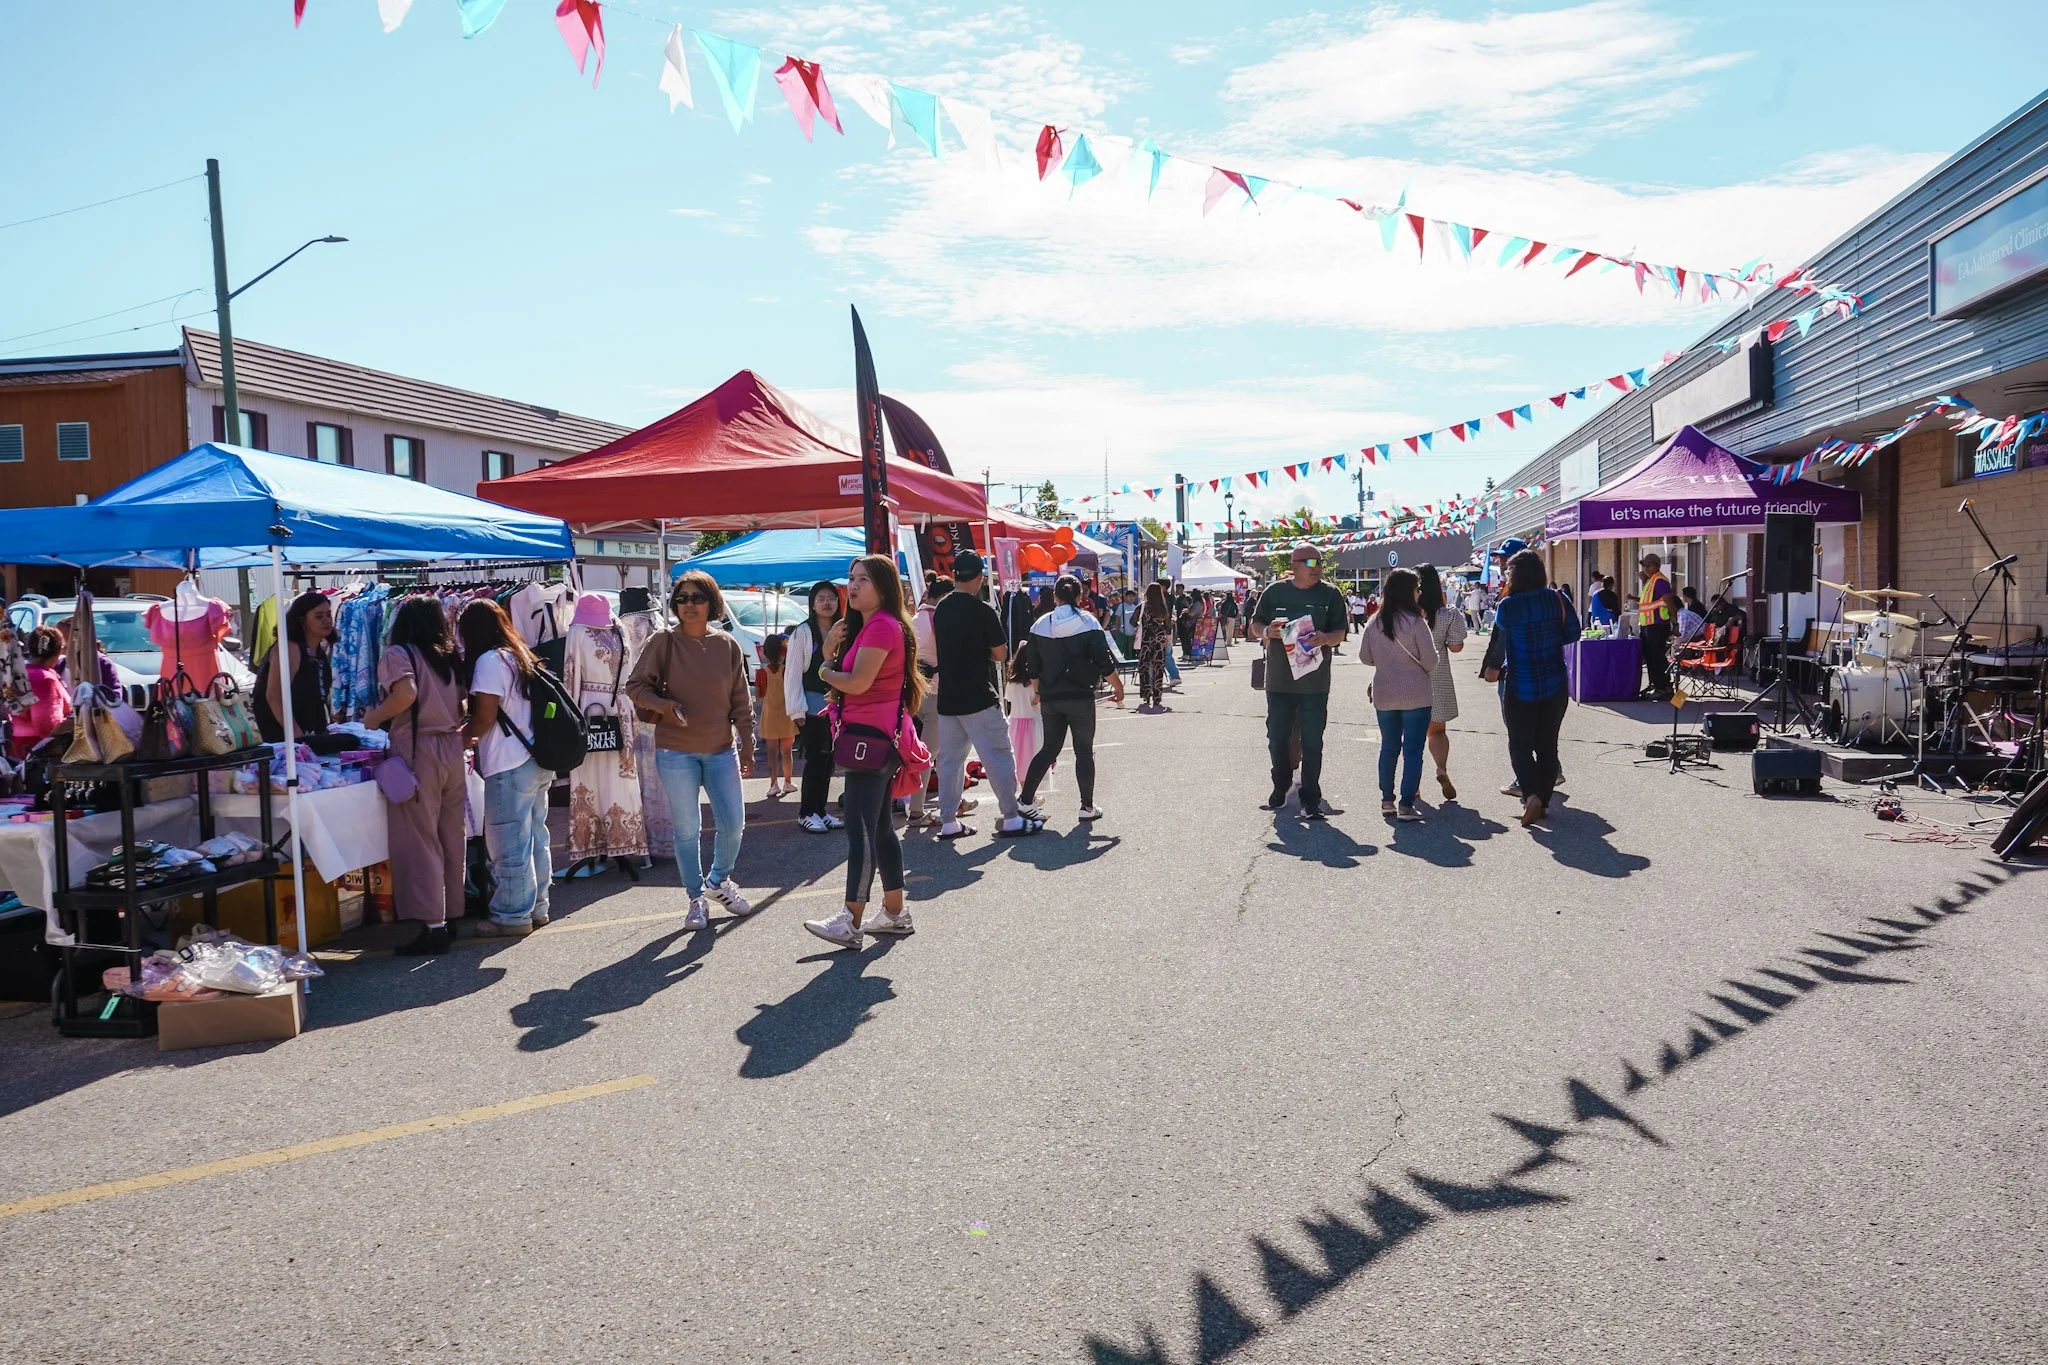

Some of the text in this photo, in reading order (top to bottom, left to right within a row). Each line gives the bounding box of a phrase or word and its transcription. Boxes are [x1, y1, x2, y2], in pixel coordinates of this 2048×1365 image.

[1970, 235, 2013, 273] Advanced
[1974, 443, 2014, 474] MASSAGE
[1610, 507, 1641, 521] let's
[1643, 505, 1684, 519] make
[1688, 504, 1712, 517] the
[1715, 502, 1761, 517] future
[587, 740, 616, 750] OMAN
[589, 731, 616, 741] NTLE
